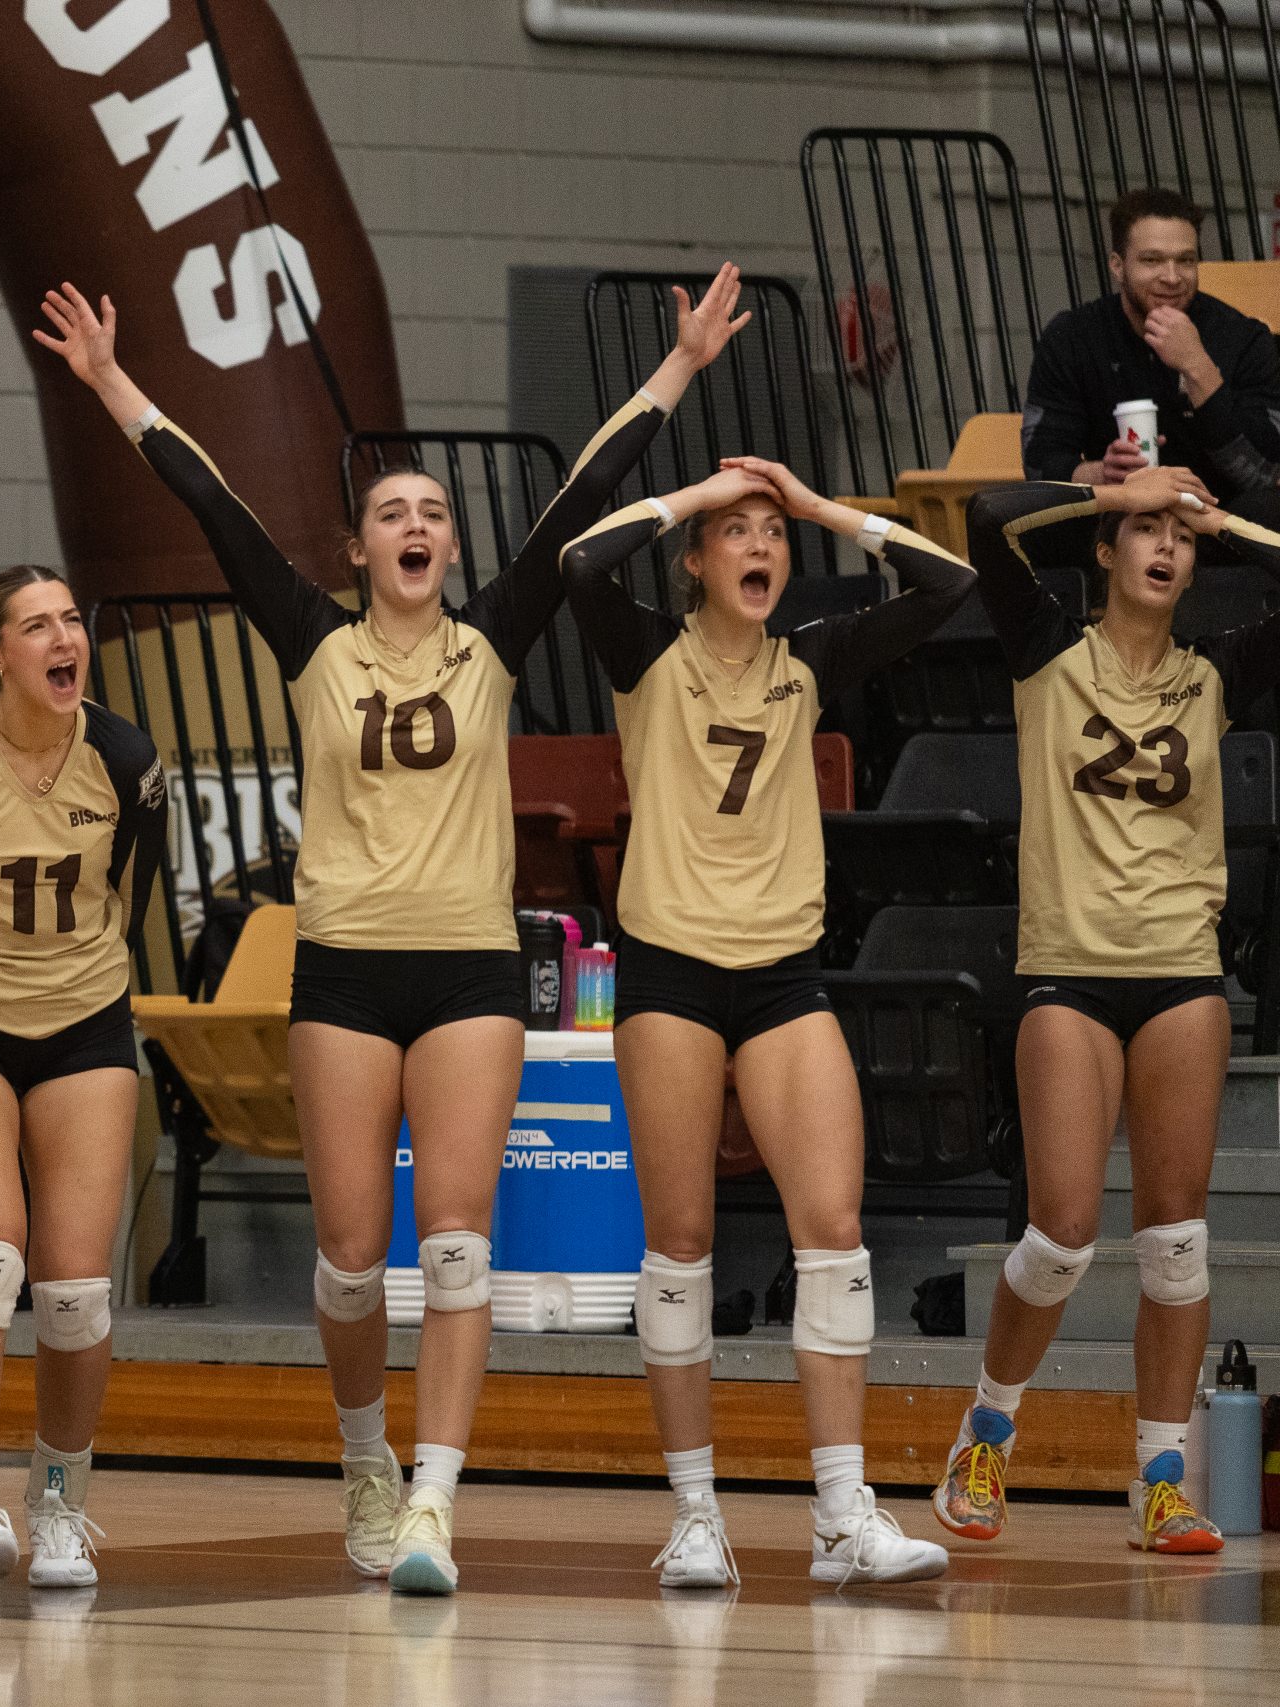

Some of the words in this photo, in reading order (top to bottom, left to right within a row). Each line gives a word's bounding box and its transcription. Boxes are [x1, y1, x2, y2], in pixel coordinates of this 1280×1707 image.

[354, 689, 456, 770] 10
[707, 724, 767, 815] 7
[1073, 714, 1191, 808] 23
[1, 853, 81, 934] 11
